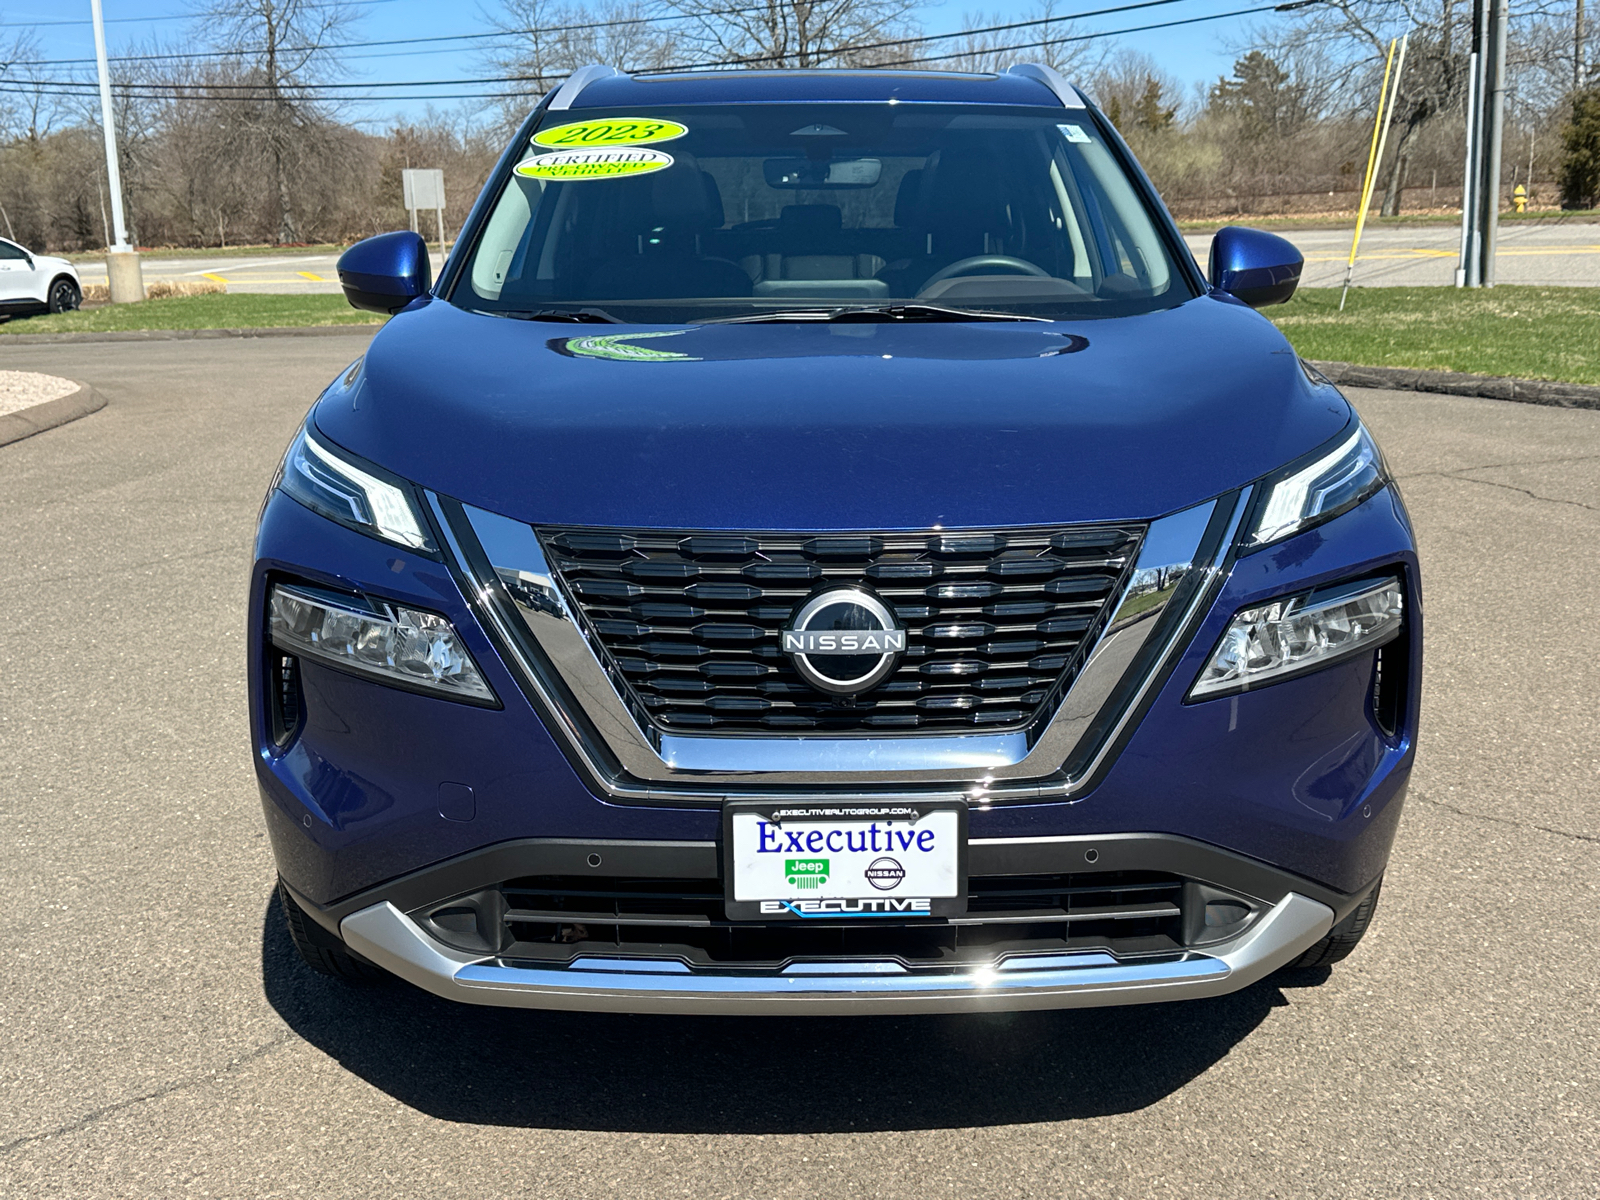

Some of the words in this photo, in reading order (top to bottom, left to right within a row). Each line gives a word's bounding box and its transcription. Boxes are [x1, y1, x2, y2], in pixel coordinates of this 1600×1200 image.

[552, 124, 665, 144] 2023
[536, 153, 657, 166] CERTIFIED
[536, 163, 646, 172] PRE-OWNED
[551, 168, 625, 176] VEHICLE
[786, 634, 902, 650] NISSAN
[780, 808, 911, 816] EXECUTIVEAUTOGROUP.COM
[757, 821, 935, 853] Executive
[791, 860, 824, 873] Jeep
[760, 898, 931, 914] EXECUTIVE
